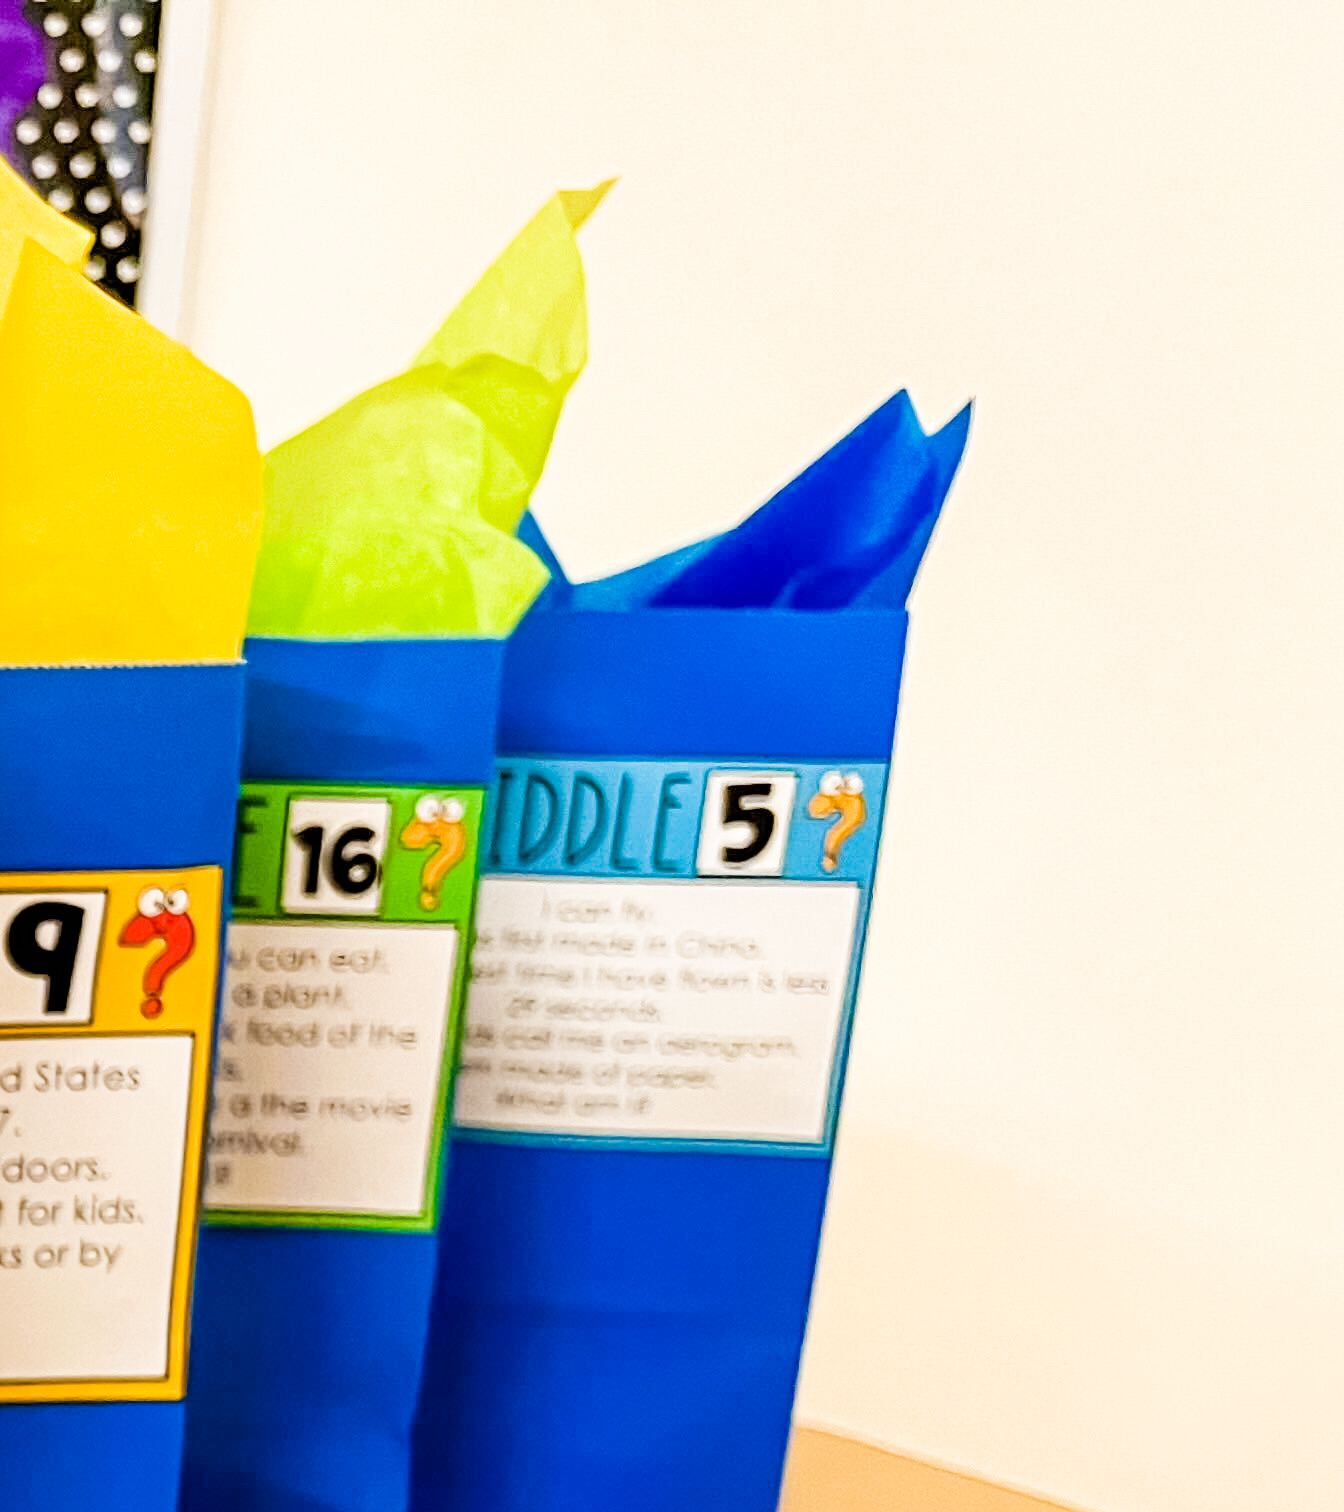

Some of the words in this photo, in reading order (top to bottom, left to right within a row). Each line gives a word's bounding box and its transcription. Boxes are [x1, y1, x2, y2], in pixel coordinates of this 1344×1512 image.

[723, 783, 774, 863] 5
[293, 826, 377, 896] 16
[7, 902, 85, 1014] 9
[258, 948, 319, 972] can
[34, 1065, 140, 1093] States
[18, 1194, 62, 1226] for
[73, 1193, 143, 1226] kids.
[34, 1241, 66, 1268] or
[78, 1239, 124, 1273] by
